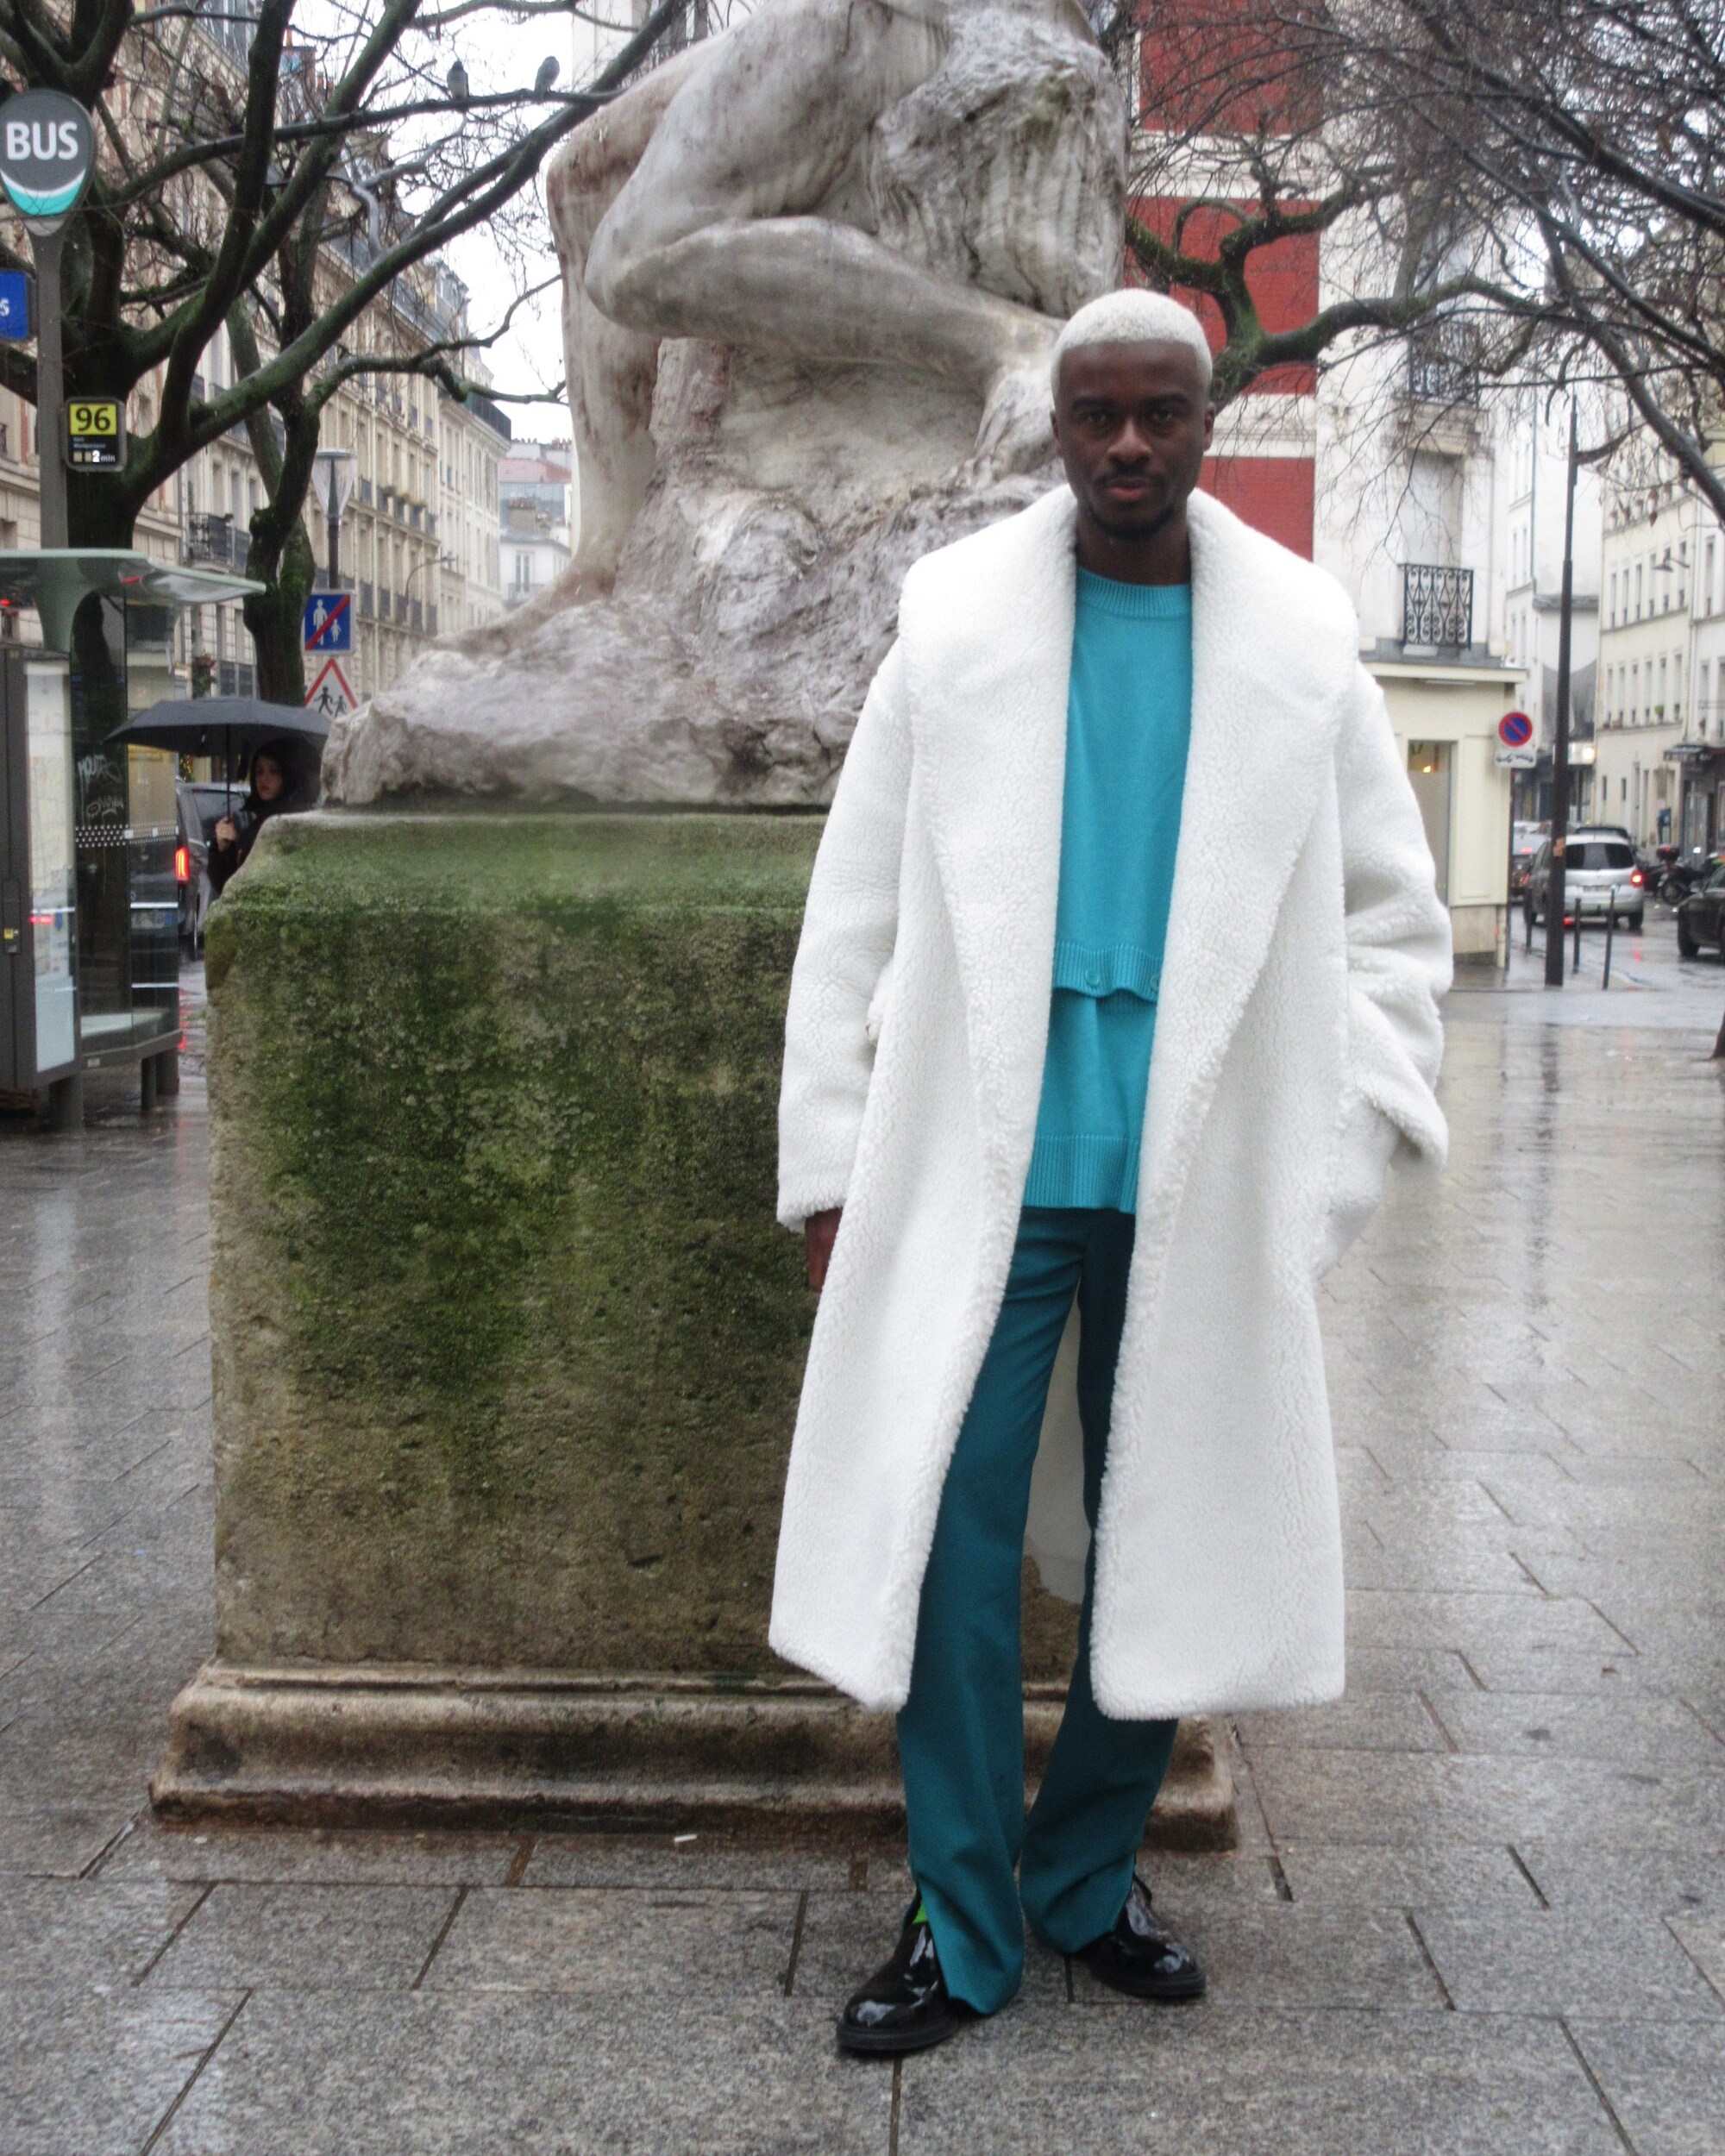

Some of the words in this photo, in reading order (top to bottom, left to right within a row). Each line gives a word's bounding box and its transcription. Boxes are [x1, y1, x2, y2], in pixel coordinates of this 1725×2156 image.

[7, 122, 78, 160] BUS
[76, 407, 110, 431] 96
[91, 449, 100, 463] 2
[101, 454, 116, 462] min
